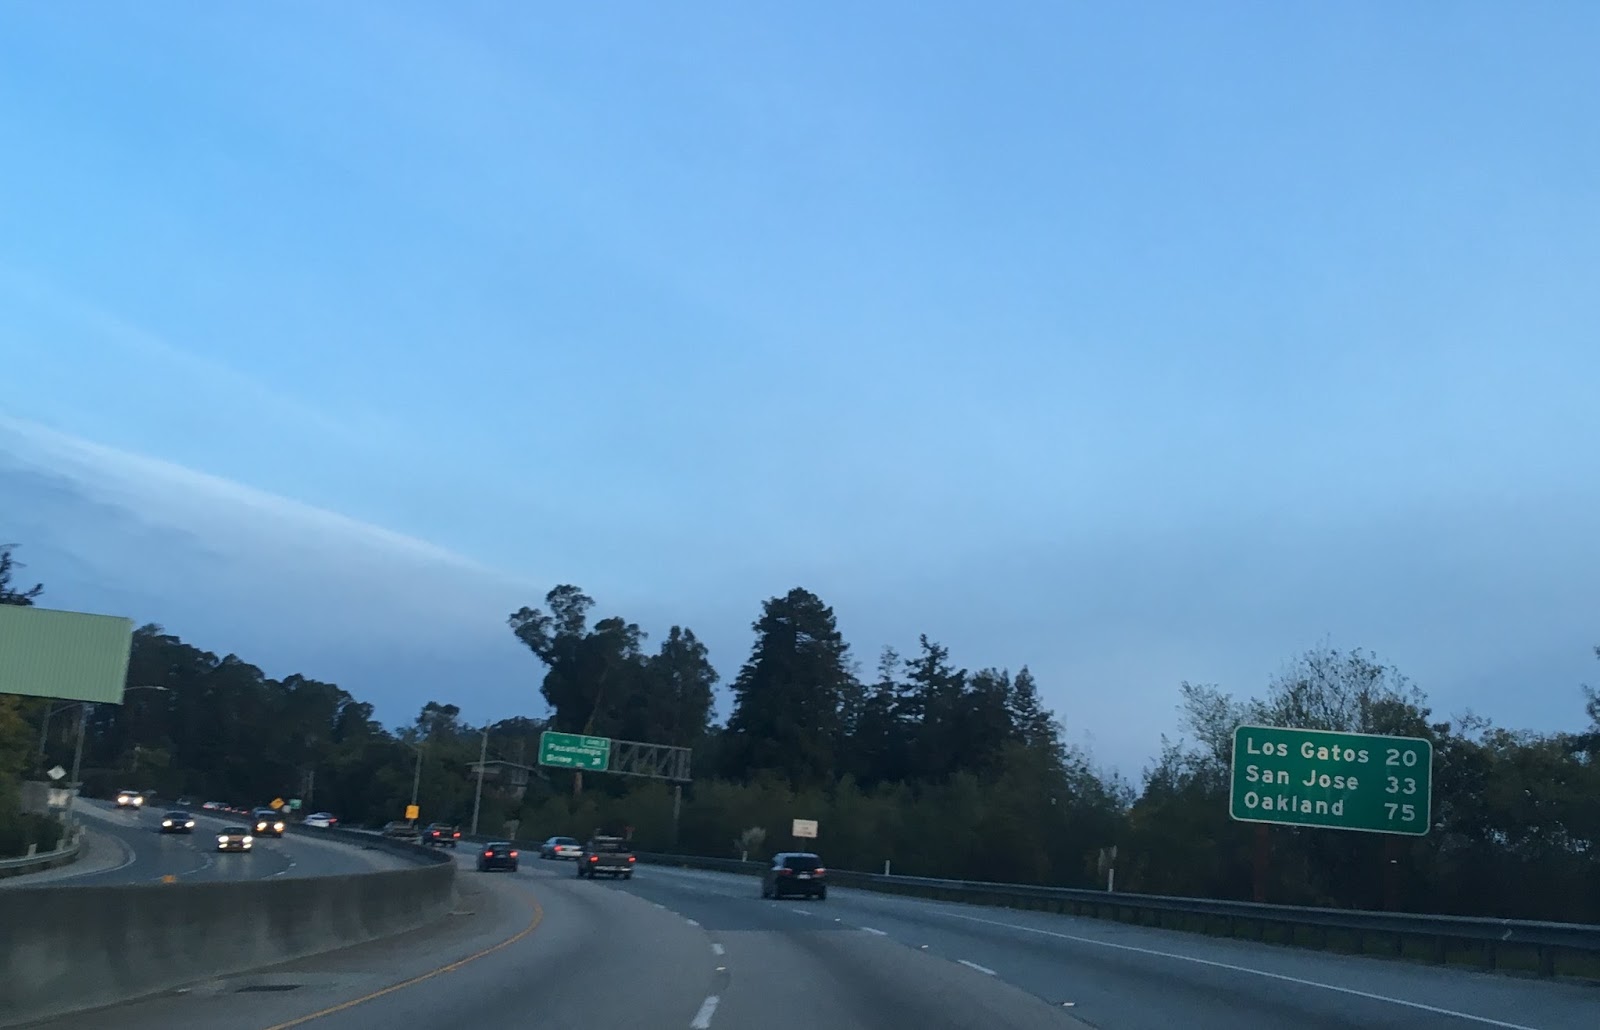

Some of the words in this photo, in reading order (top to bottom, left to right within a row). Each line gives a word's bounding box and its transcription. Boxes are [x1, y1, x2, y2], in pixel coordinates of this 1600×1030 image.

[1246, 737, 1289, 757] Los
[1300, 741, 1370, 763] Gatos
[1385, 748, 1417, 767] 20
[1245, 765, 1289, 785] San
[1302, 770, 1359, 790] Jose
[1385, 776, 1416, 795] 33
[1244, 791, 1344, 816] Oakland
[1384, 802, 1416, 822] 75
